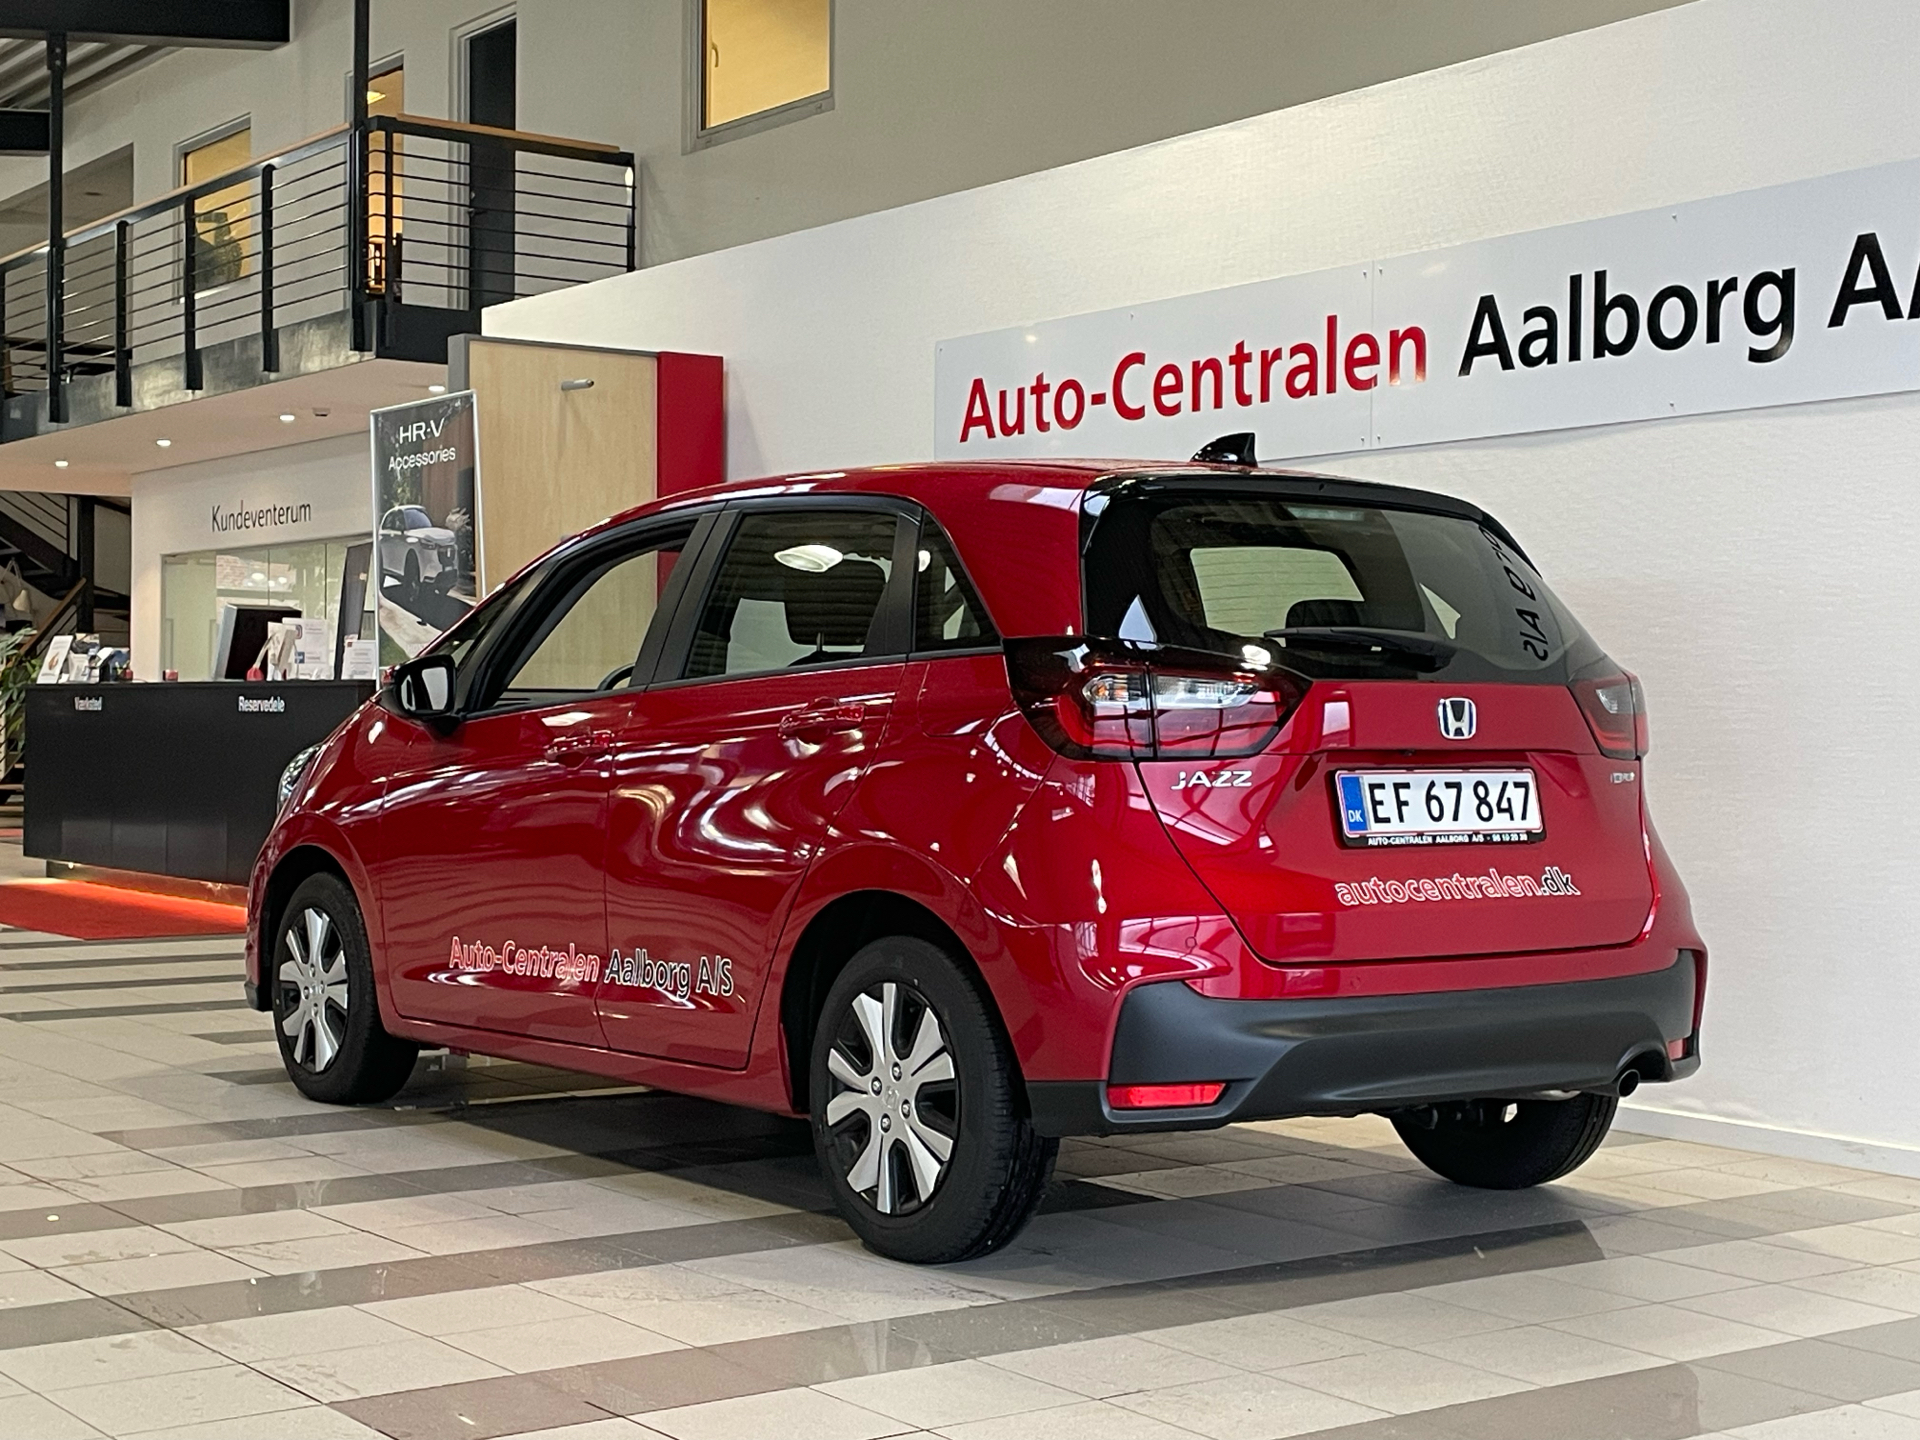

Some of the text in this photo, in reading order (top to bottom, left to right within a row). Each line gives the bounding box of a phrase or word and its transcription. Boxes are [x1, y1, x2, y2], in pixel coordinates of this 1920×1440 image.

[959, 232, 1920, 443] Auto-Centralen Aalborg A
[388, 445, 457, 472] Accessories
[211, 499, 312, 532] Kundeventerum
[237, 695, 286, 713] Reservedele
[1170, 770, 1252, 790] JAZZ
[1348, 809, 1364, 823] DK
[1368, 779, 1530, 824] EF 67 847
[1367, 835, 1433, 846] AUTO-CENTRALEN
[1435, 833, 1470, 844] AALBORG
[1334, 866, 1582, 907] autocentralen.dk
[449, 936, 735, 1000] Auto-Centralen Aalborg A/S
